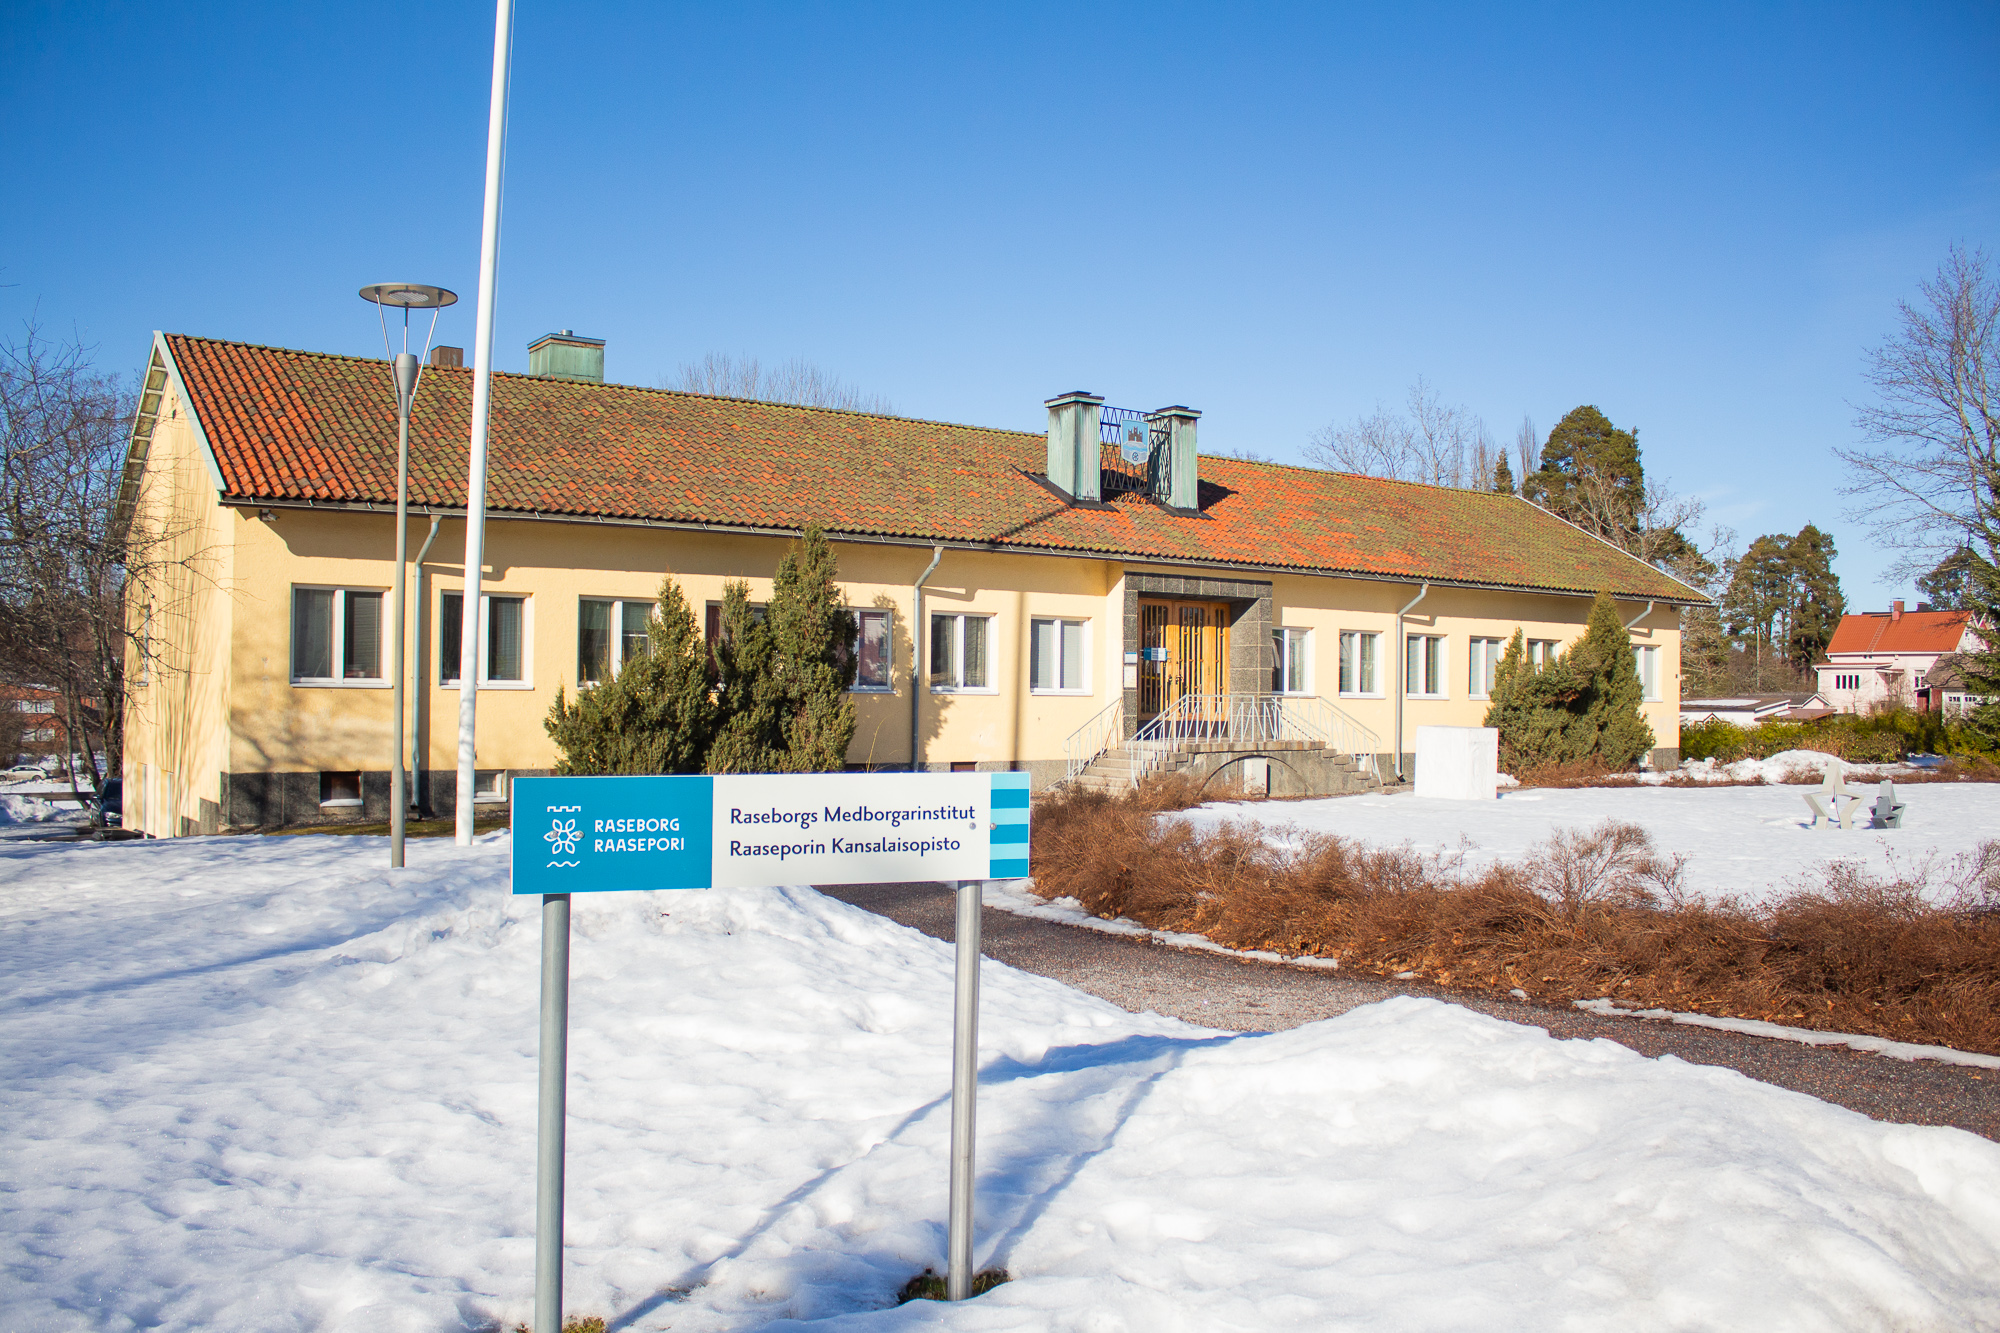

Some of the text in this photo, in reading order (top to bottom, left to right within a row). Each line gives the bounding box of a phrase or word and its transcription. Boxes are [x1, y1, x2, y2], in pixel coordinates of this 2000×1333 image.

[594, 818, 680, 833] RASEBORG
[730, 805, 976, 830] Raseborgs Medborgarinstitut
[594, 837, 685, 853] RAASEPORI
[730, 836, 961, 861] Raaseporin Kansalaisopisto
